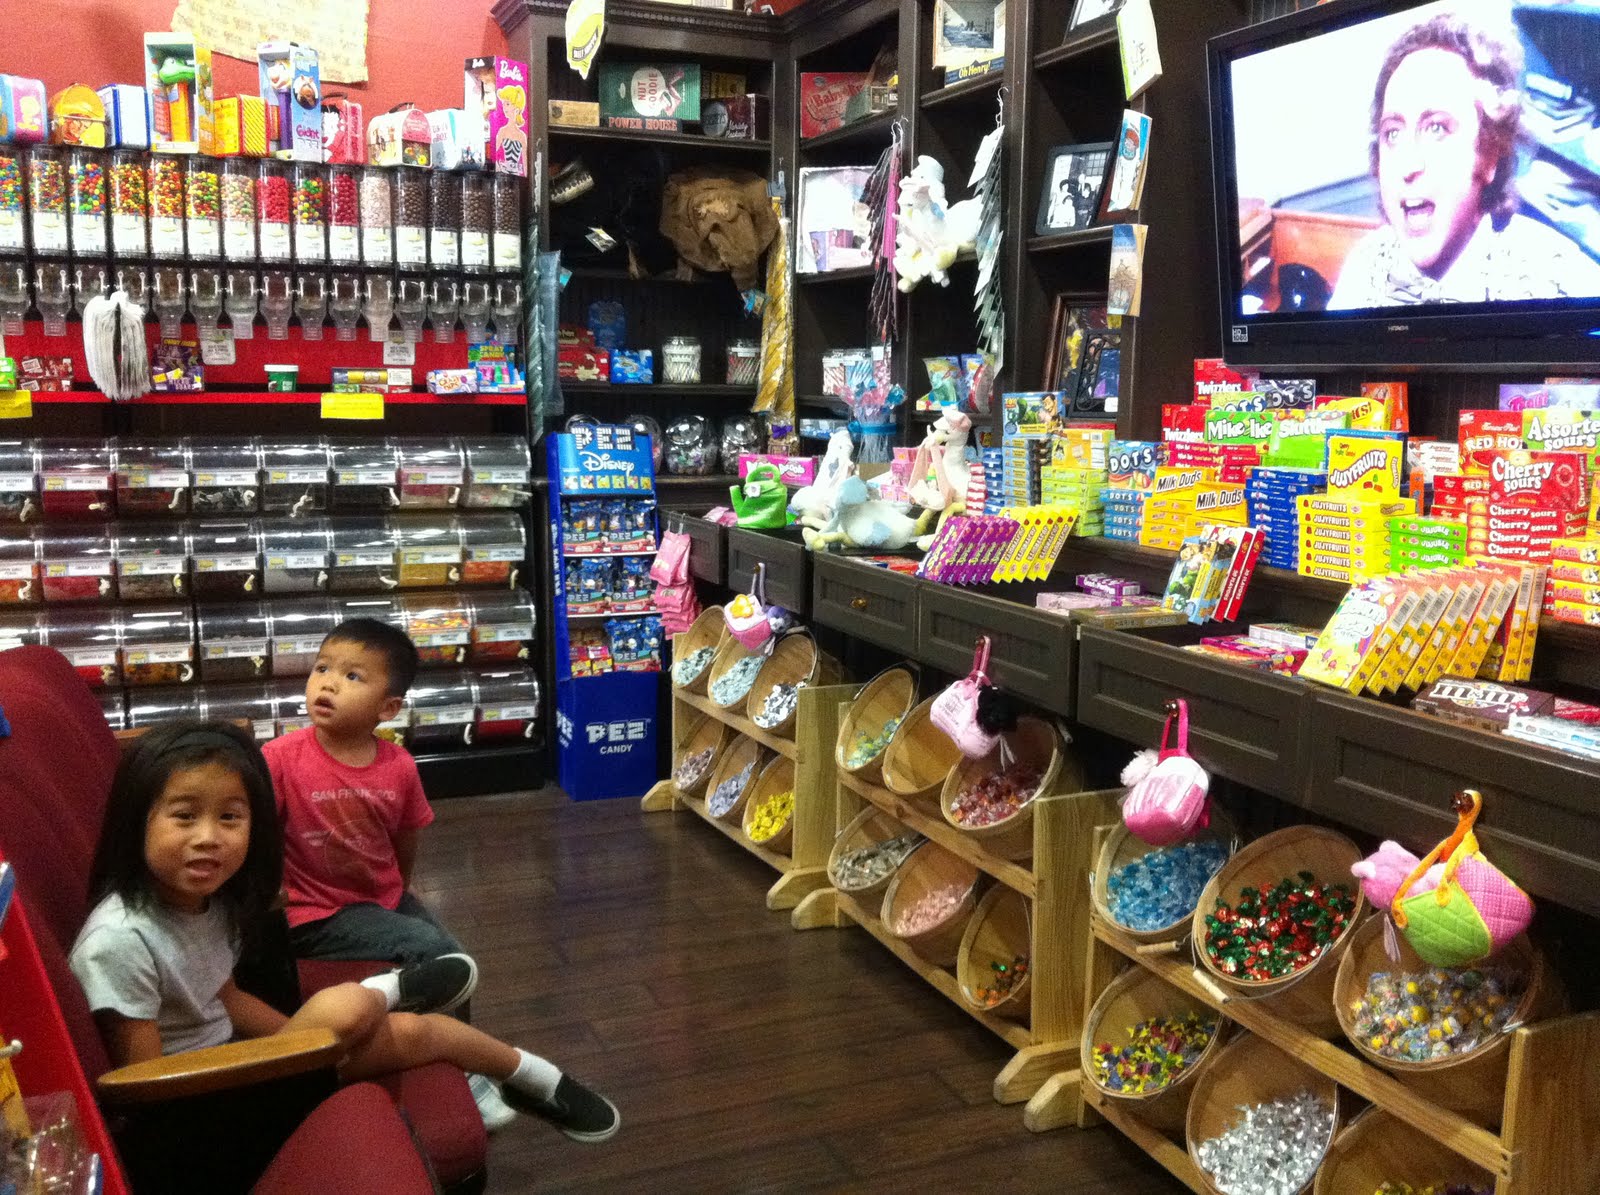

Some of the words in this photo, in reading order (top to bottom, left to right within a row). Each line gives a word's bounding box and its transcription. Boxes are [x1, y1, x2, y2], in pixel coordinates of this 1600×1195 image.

[500, 60, 525, 82] Barbie
[958, 67, 968, 77] Oh
[969, 60, 992, 75] Henry!
[637, 82, 646, 101] NUT
[649, 72, 657, 109] OODIE
[608, 117, 643, 129] POWER
[645, 118, 678, 131] HOUSE
[1196, 381, 1242, 395] Twizzlers
[1207, 418, 1246, 440] Mike
[1249, 418, 1273, 439] Ike
[1528, 416, 1600, 442] Assorte
[571, 427, 633, 451] PEZ
[1464, 436, 1493, 451] RED
[1497, 435, 1523, 450] HO
[1543, 434, 1596, 452] sours
[579, 451, 635, 477] Disney
[1109, 449, 1152, 473] DOTS
[1329, 450, 1387, 488] JUJYFRUITS
[1492, 456, 1555, 482] Cherry
[1156, 475, 1178, 492] Milk
[1178, 471, 1202, 487] Duds
[1503, 475, 1542, 493] sours
[1109, 493, 1132, 501] DOTS
[1196, 492, 1216, 510] Milk
[1218, 490, 1242, 506] Duds
[1114, 504, 1135, 513] DOTS
[1311, 501, 1348, 513] JUJYFRUITS
[1489, 504, 1530, 518] Cherry
[1530, 510, 1557, 518] sours
[1112, 516, 1132, 525] DOTS
[1313, 515, 1350, 527] JUJYFRUITS
[1489, 518, 1530, 531] Cherry
[1530, 524, 1558, 532] sours
[1112, 529, 1132, 538] DOTS
[1313, 528, 1350, 540] JUJYFRUITS
[1488, 531, 1530, 544] Cherry
[1530, 537, 1552, 545] sour
[1313, 541, 1350, 554] JUJYFRUITS
[1487, 543, 1529, 555] Cherry
[1529, 549, 1551, 557] sour
[1313, 554, 1350, 567] JUJYFRUITS
[1313, 567, 1350, 580] JUJYFRUITS
[585, 722, 646, 744] PEZ
[600, 744, 633, 755] CANDY
[311, 790, 336, 802] SAN
